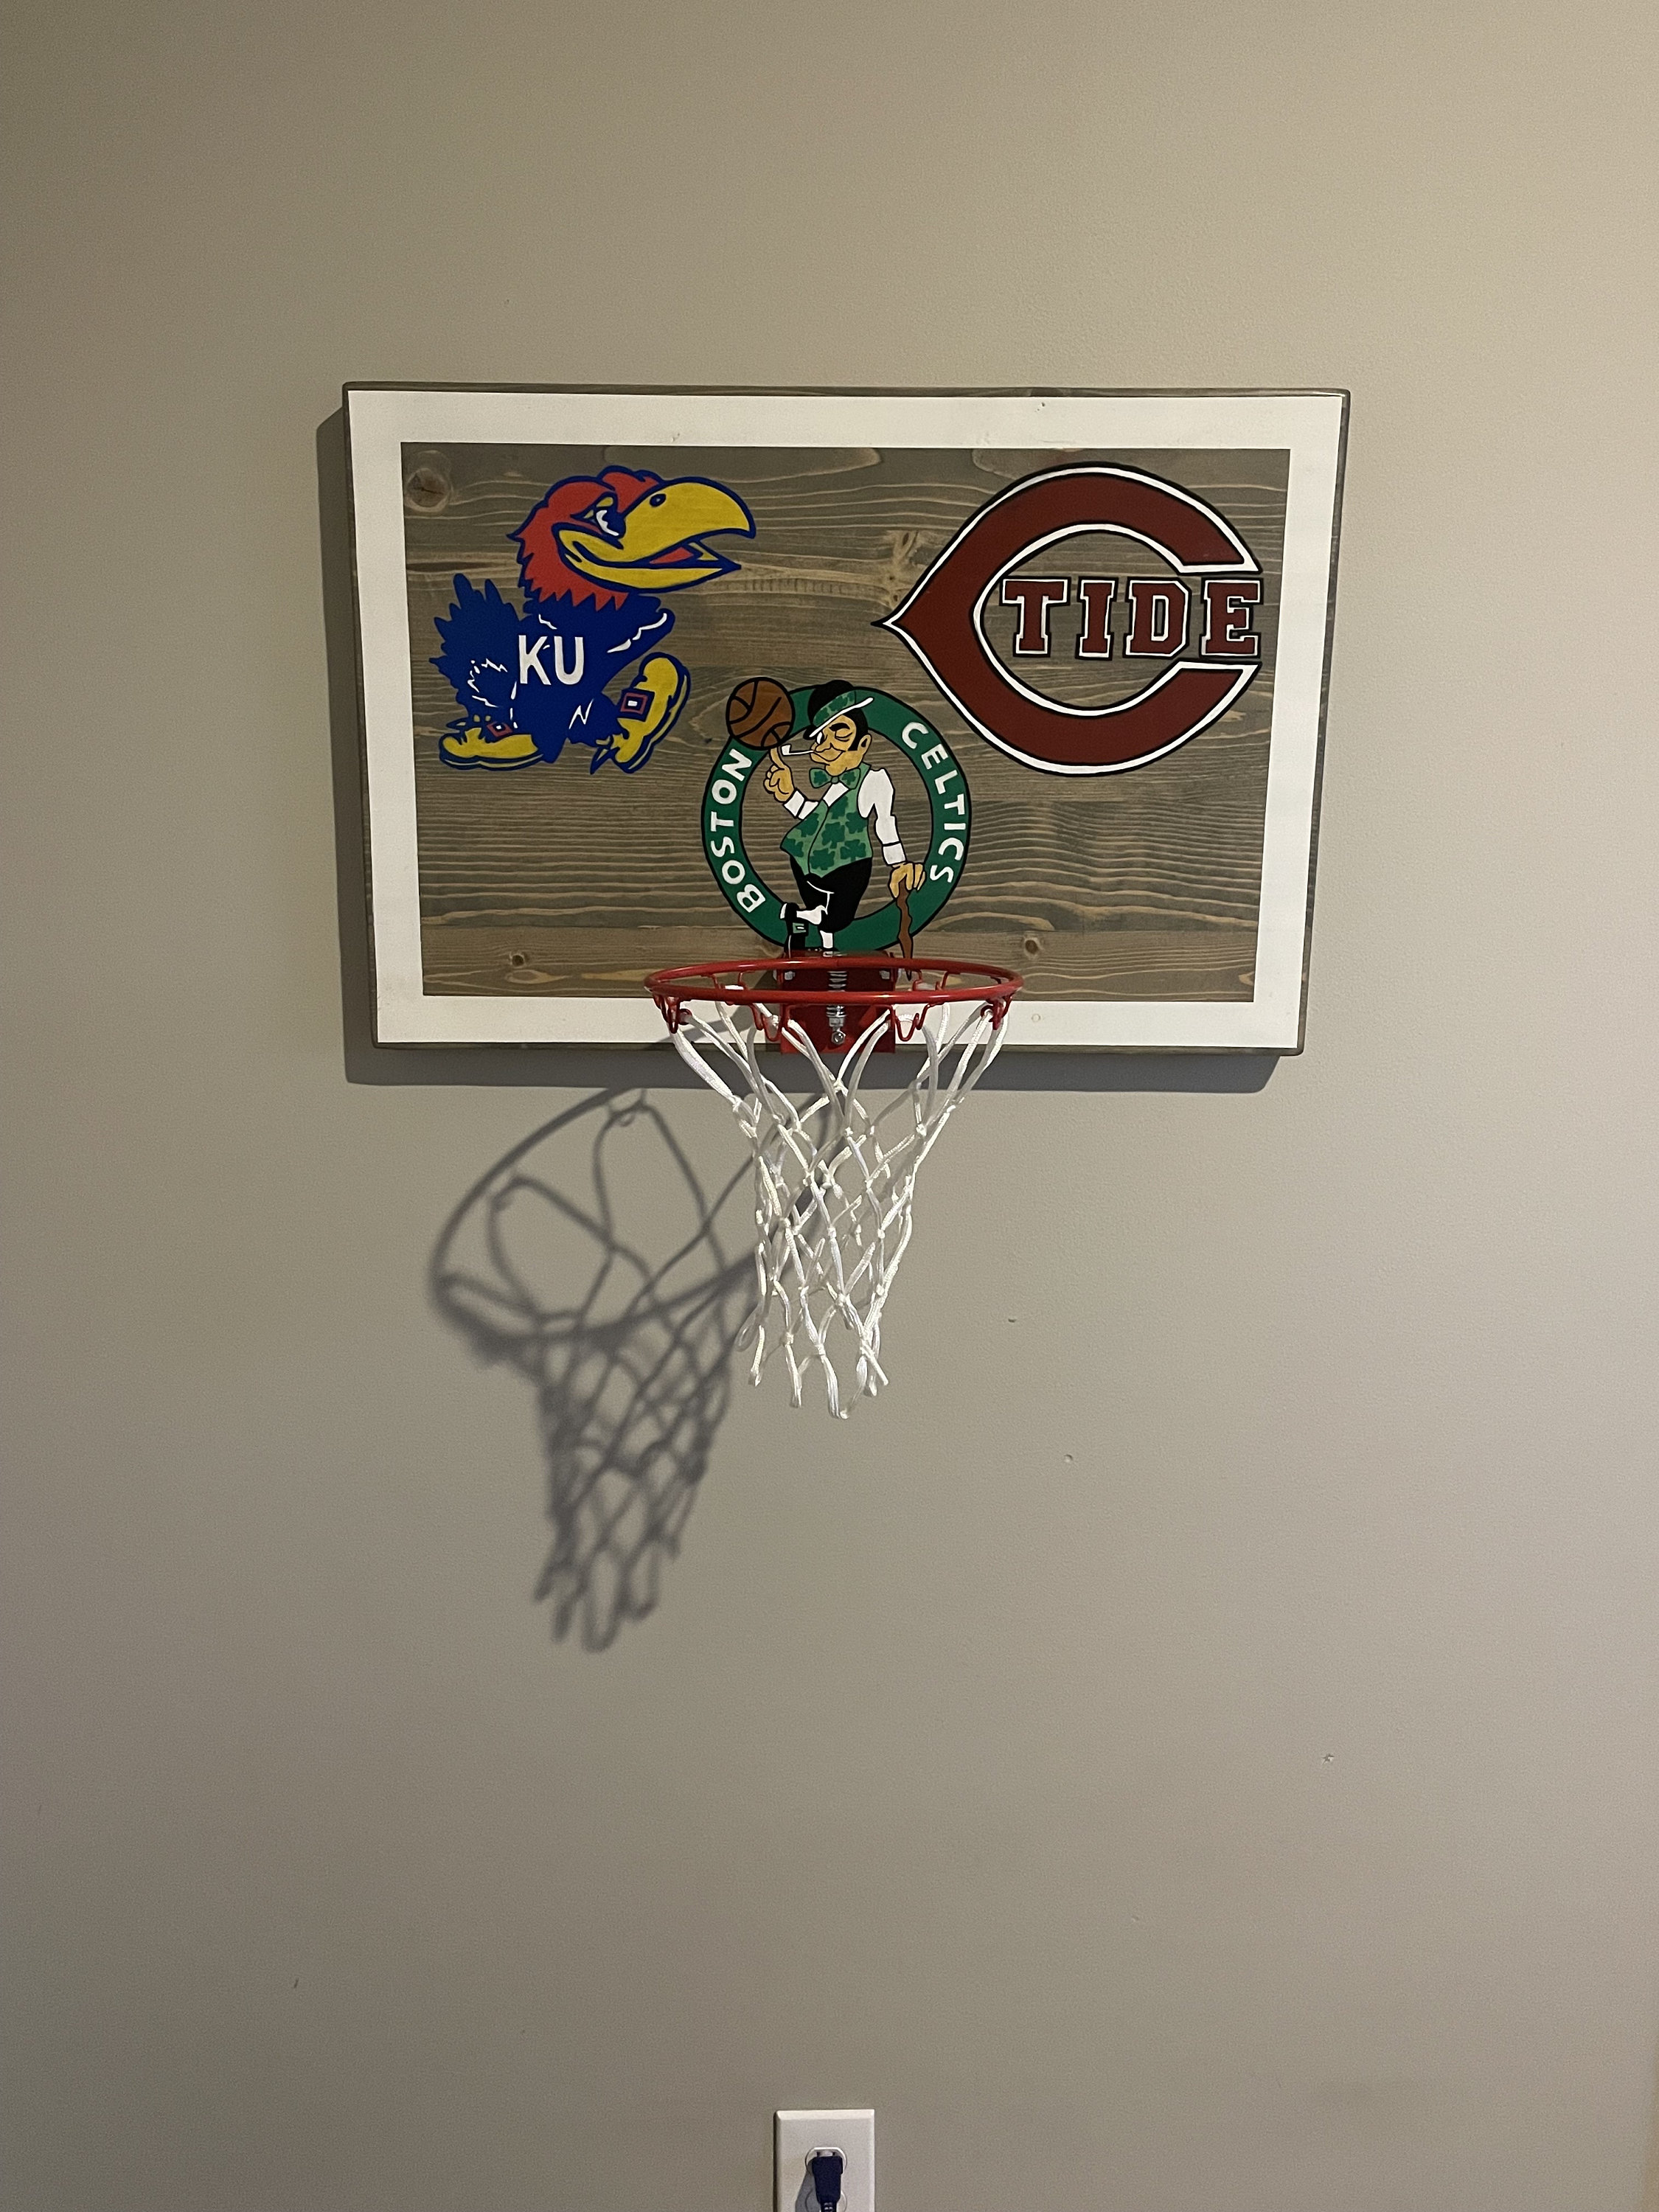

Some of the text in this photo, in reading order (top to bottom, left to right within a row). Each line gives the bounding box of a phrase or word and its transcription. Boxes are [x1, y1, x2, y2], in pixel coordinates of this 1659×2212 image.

[518, 634, 585, 686] KU
[999, 577, 1264, 660] TIDE
[710, 721, 967, 913] BOSTON CELTICS
